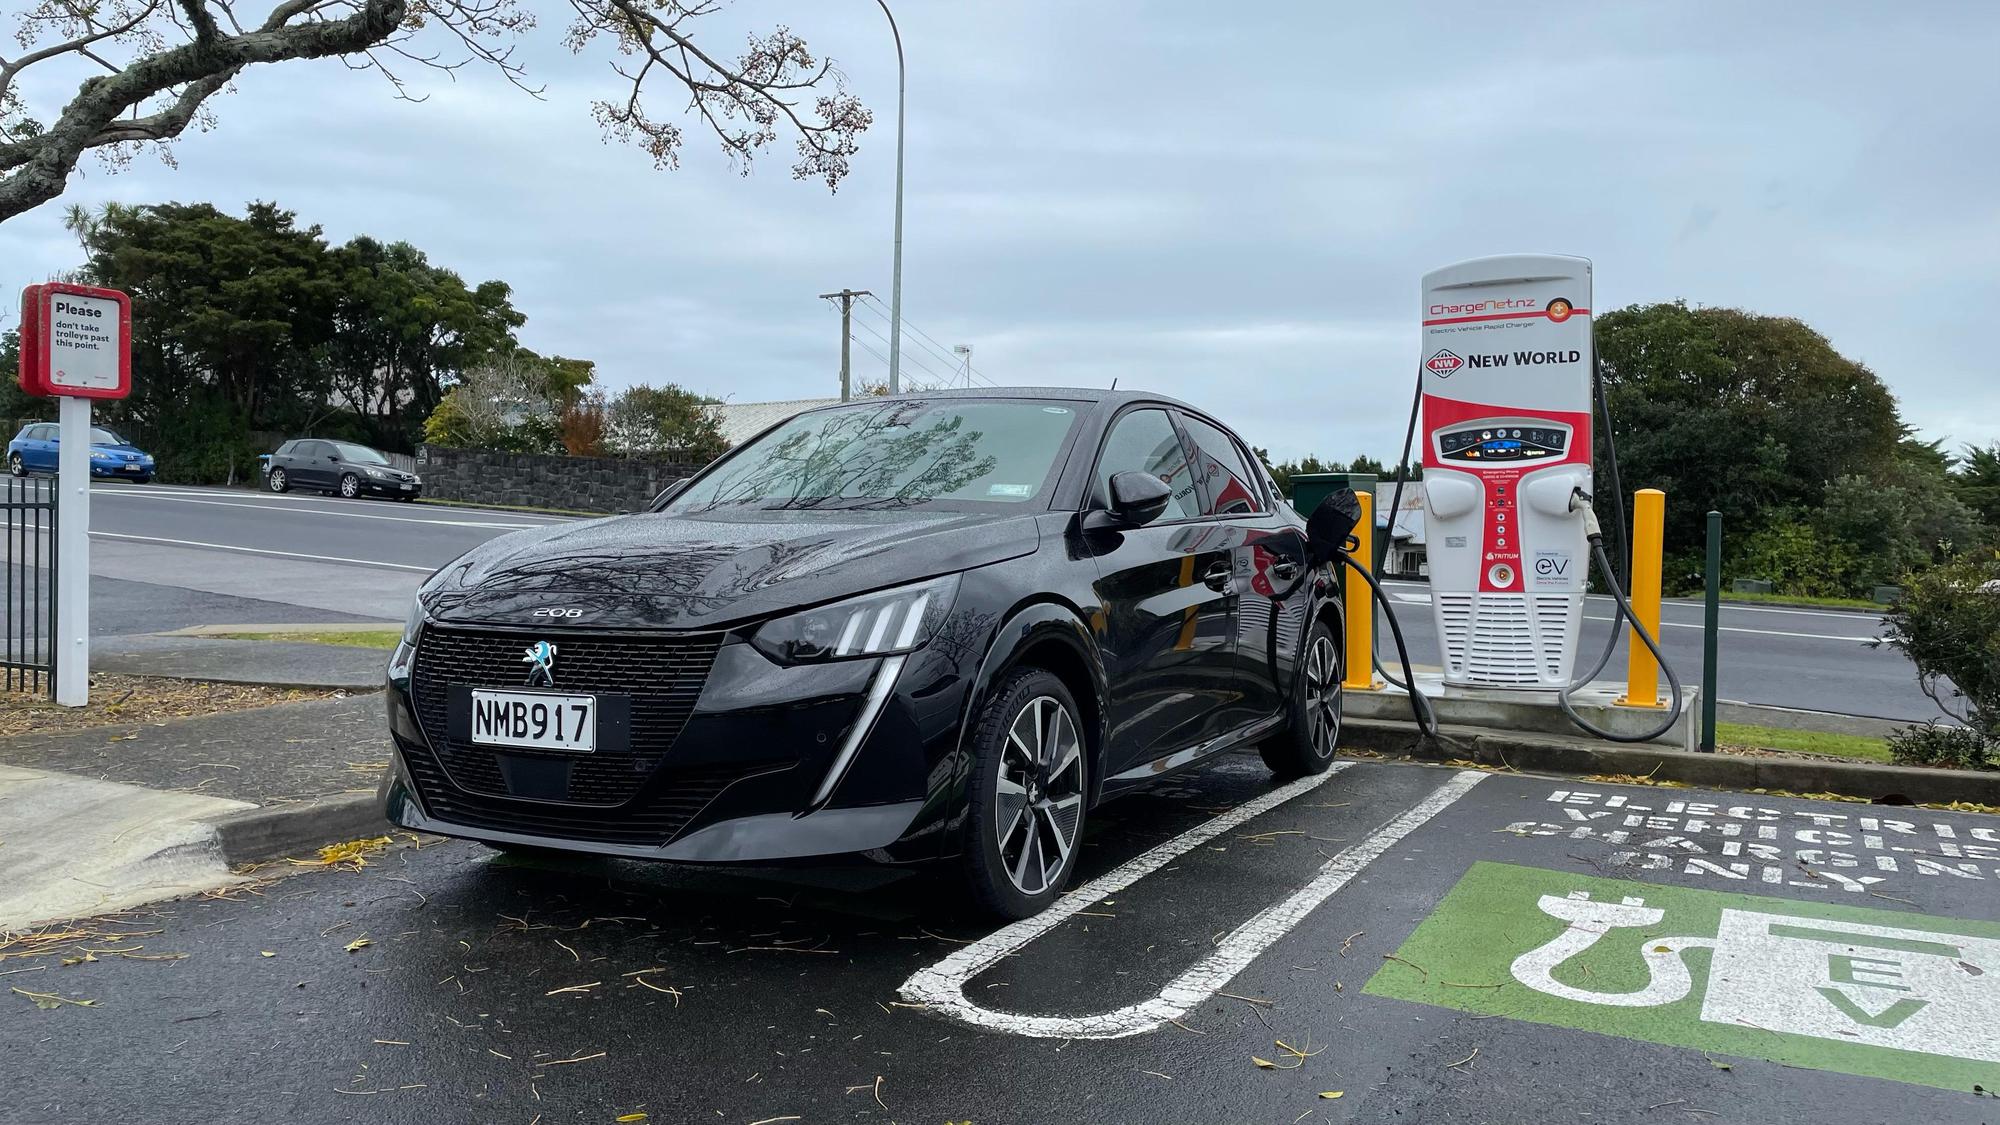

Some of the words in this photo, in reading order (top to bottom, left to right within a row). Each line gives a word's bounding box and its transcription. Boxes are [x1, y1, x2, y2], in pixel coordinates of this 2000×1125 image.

[56, 302, 102, 318] Please
[1430, 299, 1536, 315] ChargeNet.nz
[56, 320, 79, 330] don't
[81, 323, 100, 332] take
[1430, 326, 1456, 334] Electric
[1484, 323, 1505, 331] Rapid
[1506, 322, 1536, 330] Charger
[56, 330, 89, 341] trolleys
[90, 334, 110, 343] past
[56, 339, 73, 347] this
[74, 341, 100, 350] point.
[1434, 358, 1455, 368] NW
[1468, 354, 1509, 369] NEW
[1513, 350, 1581, 365] WORLD
[533, 608, 583, 618] 208
[476, 699, 588, 742] NMB917
[1505, 822, 2000, 880] CHARGIN
